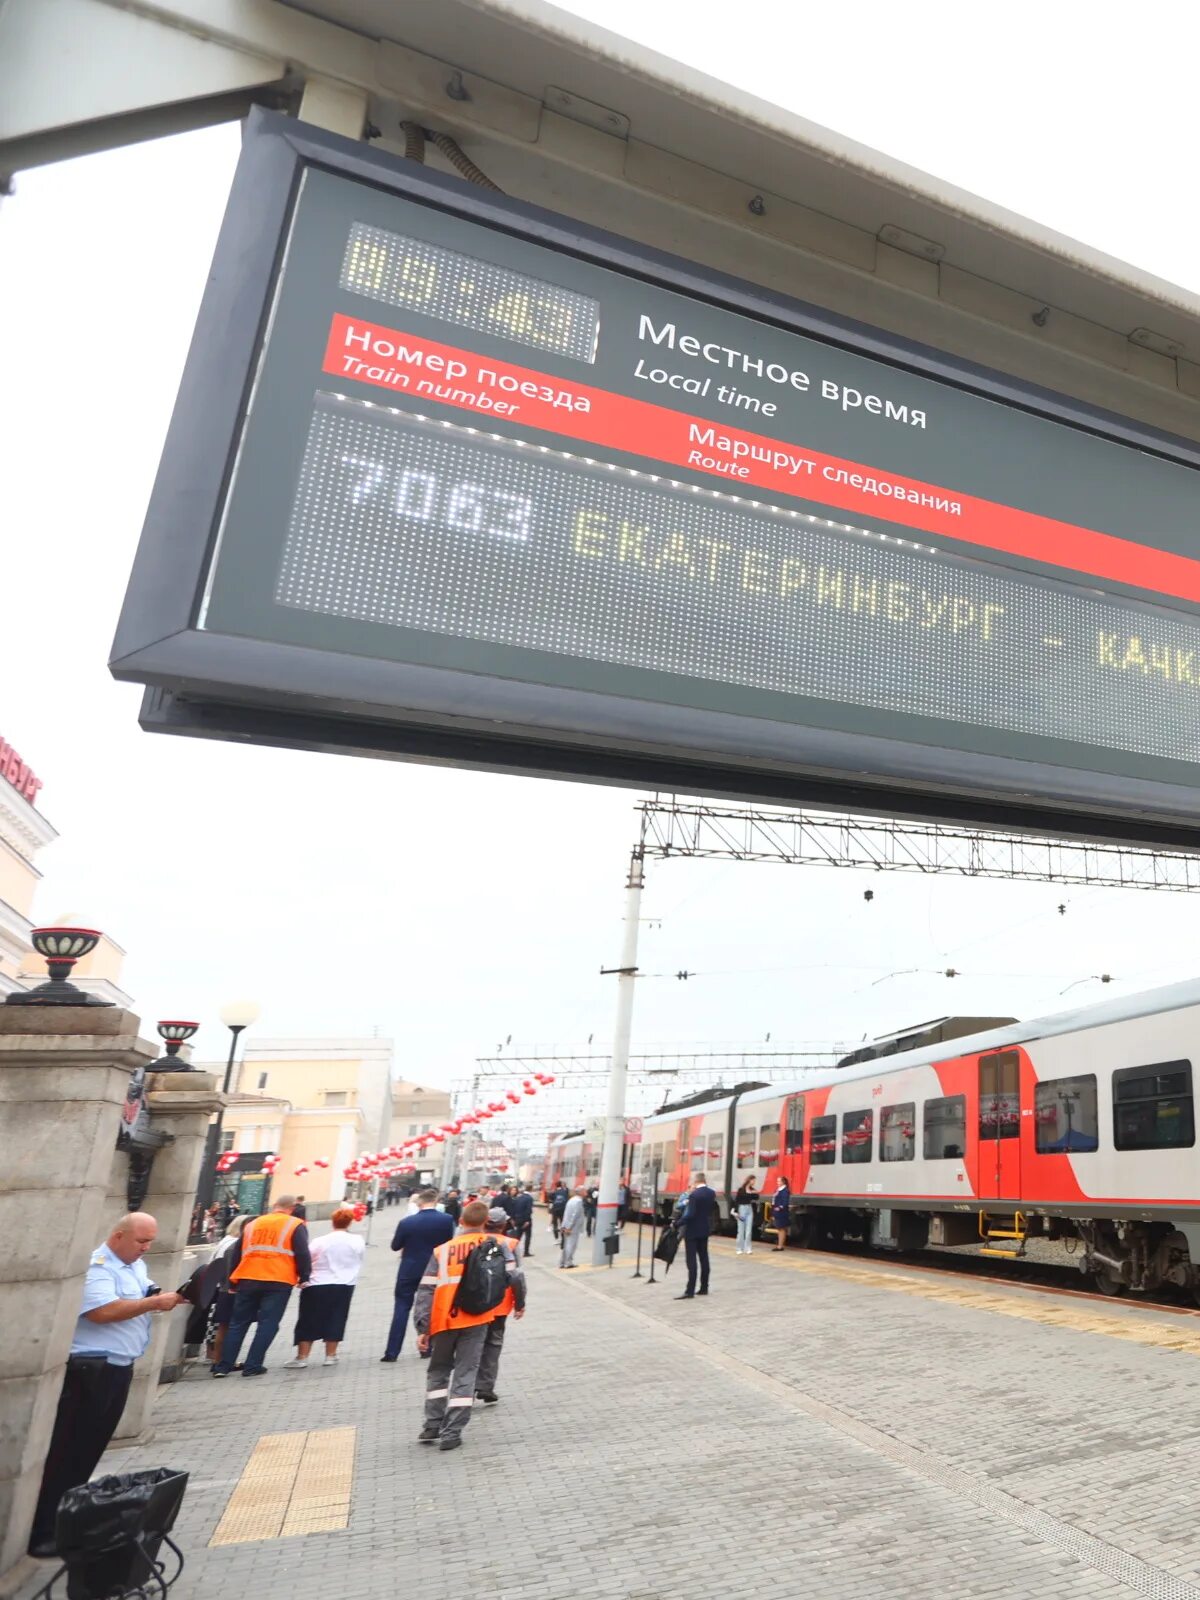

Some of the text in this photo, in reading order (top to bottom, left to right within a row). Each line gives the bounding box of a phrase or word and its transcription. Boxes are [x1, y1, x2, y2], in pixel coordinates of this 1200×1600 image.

[342, 355, 520, 416] Train number
[344, 325, 591, 413] Номер поезда
[633, 359, 777, 417] Local time
[638, 314, 927, 429] Местное время
[687, 450, 750, 478] Route
[688, 423, 961, 515] Маршрут следования
[341, 456, 532, 541] 7063
[574, 510, 1004, 640] ЕКАТЕРИНБУРГ
